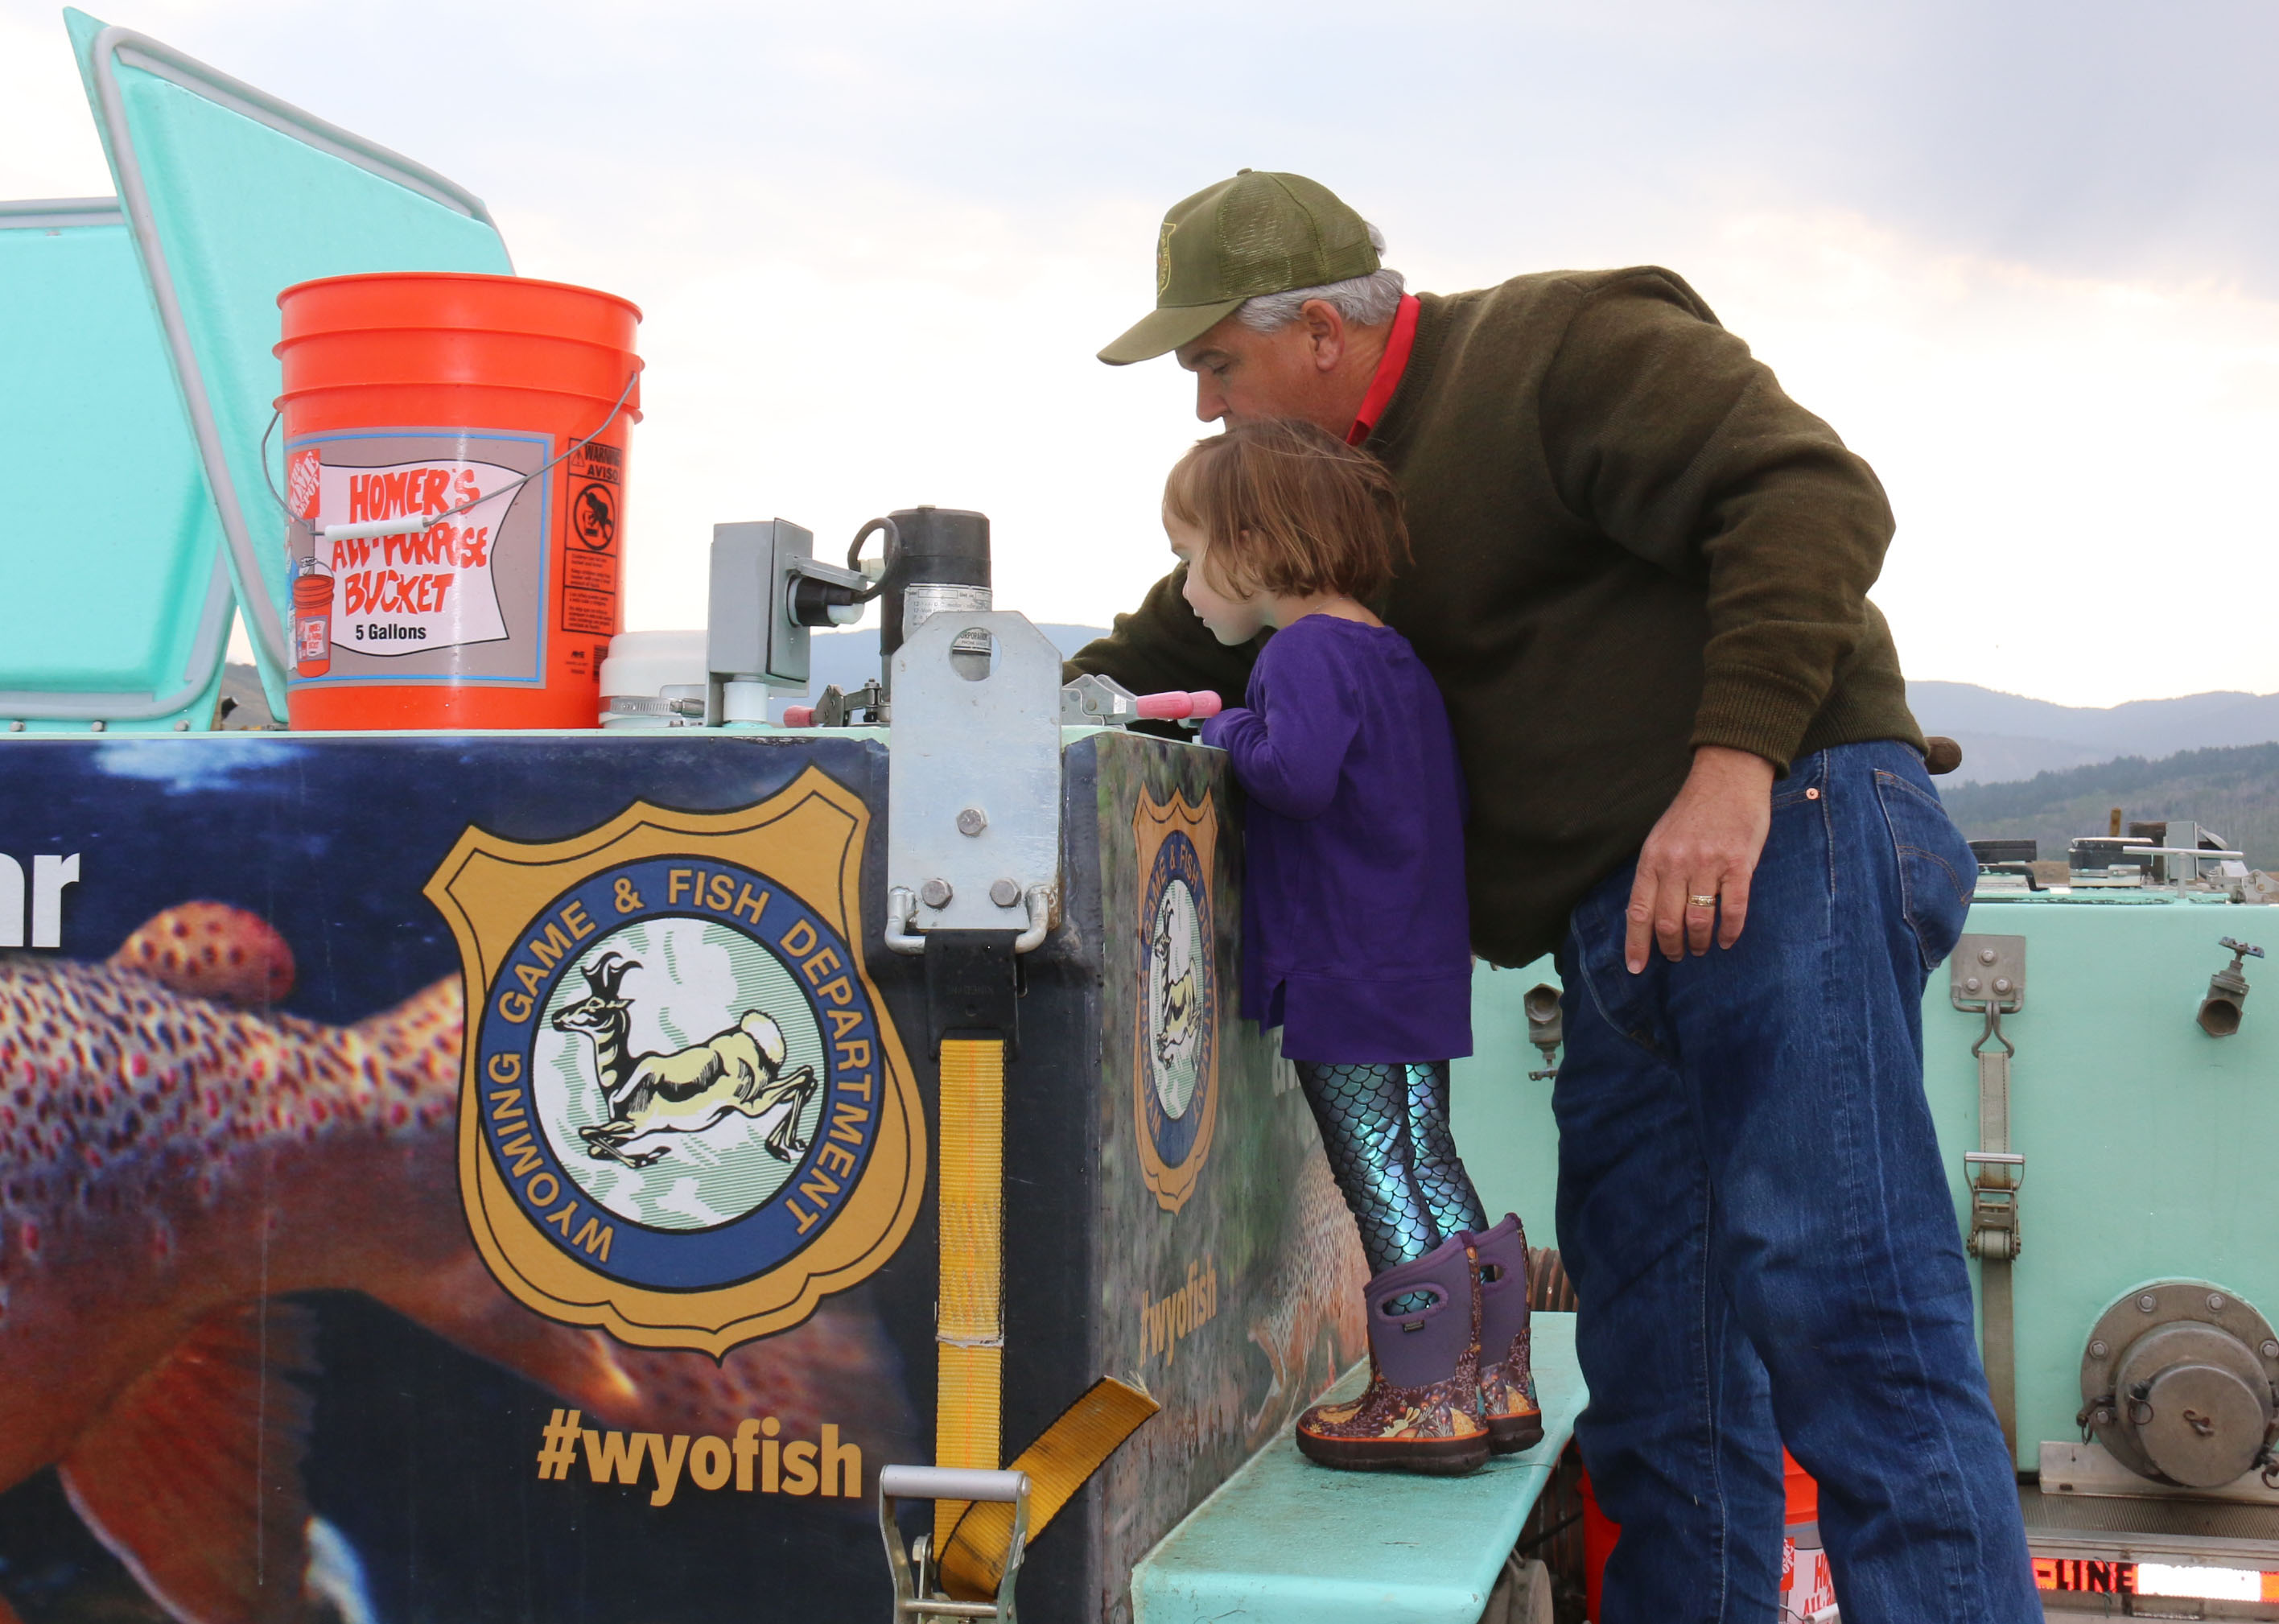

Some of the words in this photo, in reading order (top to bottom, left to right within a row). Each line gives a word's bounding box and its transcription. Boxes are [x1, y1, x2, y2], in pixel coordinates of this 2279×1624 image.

[349, 465, 480, 524] HOMER'S
[587, 464, 619, 480] AVISO
[345, 570, 455, 616] BUCKET
[356, 624, 364, 640] 5
[368, 624, 427, 640] Gallons
[613, 877, 646, 913] &
[667, 868, 769, 925] FISH
[1144, 856, 1167, 946] GAME
[1179, 843, 1200, 894] FISH
[498, 899, 597, 1024] GAME
[779, 919, 875, 1237] DEPARTMENT
[488, 1053, 615, 1263] WYOMING
[537, 1408, 862, 1507] #wyofish
